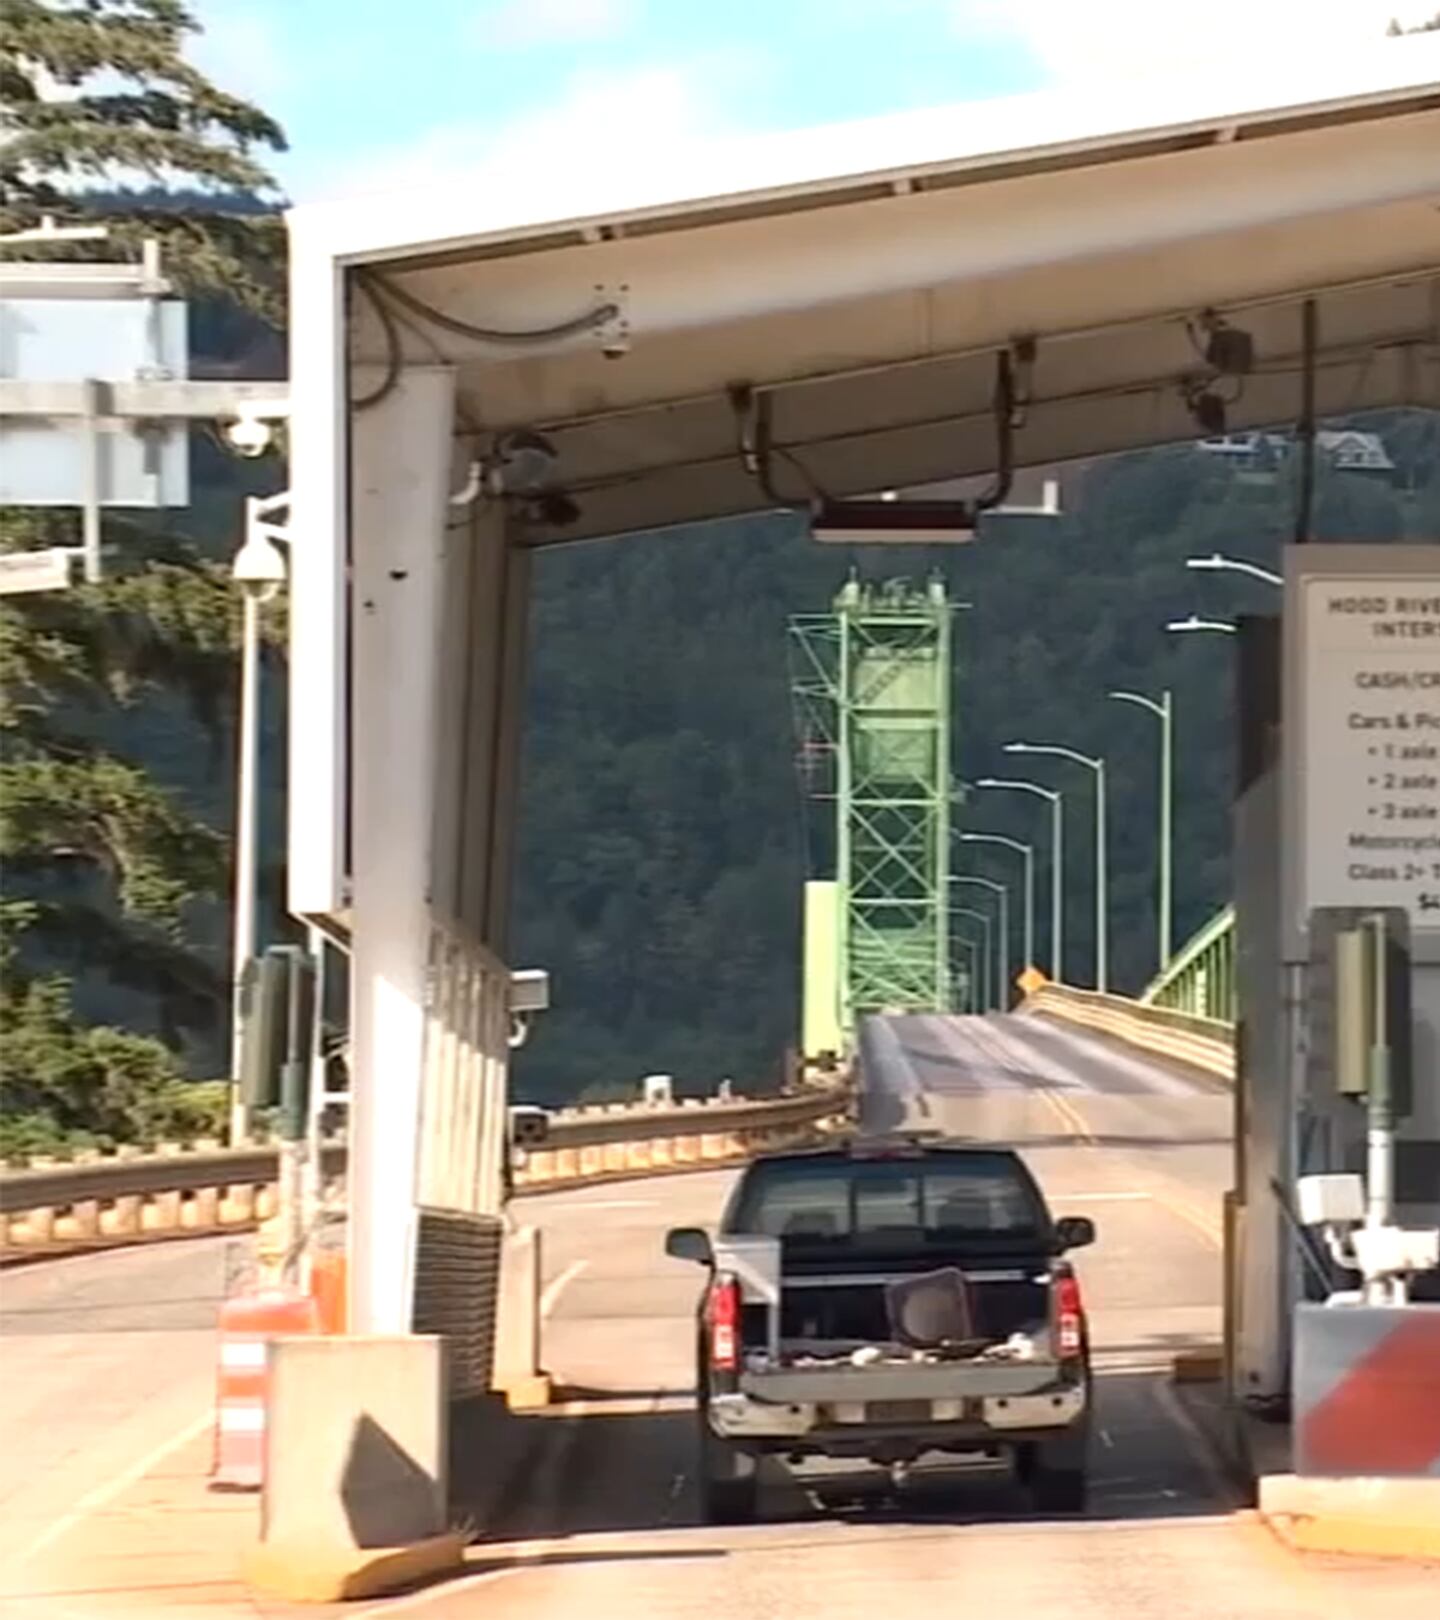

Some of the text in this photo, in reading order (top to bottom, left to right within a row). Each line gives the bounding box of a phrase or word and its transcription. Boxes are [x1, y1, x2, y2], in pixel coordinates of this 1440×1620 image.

[1328, 597, 1387, 614] HOOD
[1349, 713, 1391, 730] Cars
[1396, 713, 1410, 729] &
[1384, 743, 1395, 759] 1
[1401, 743, 1438, 759] axle
[1384, 773, 1395, 789] 2
[1401, 773, 1438, 789] axle
[1384, 803, 1395, 819] 3
[1401, 803, 1438, 819] axle
[1349, 864, 1398, 880] Class
